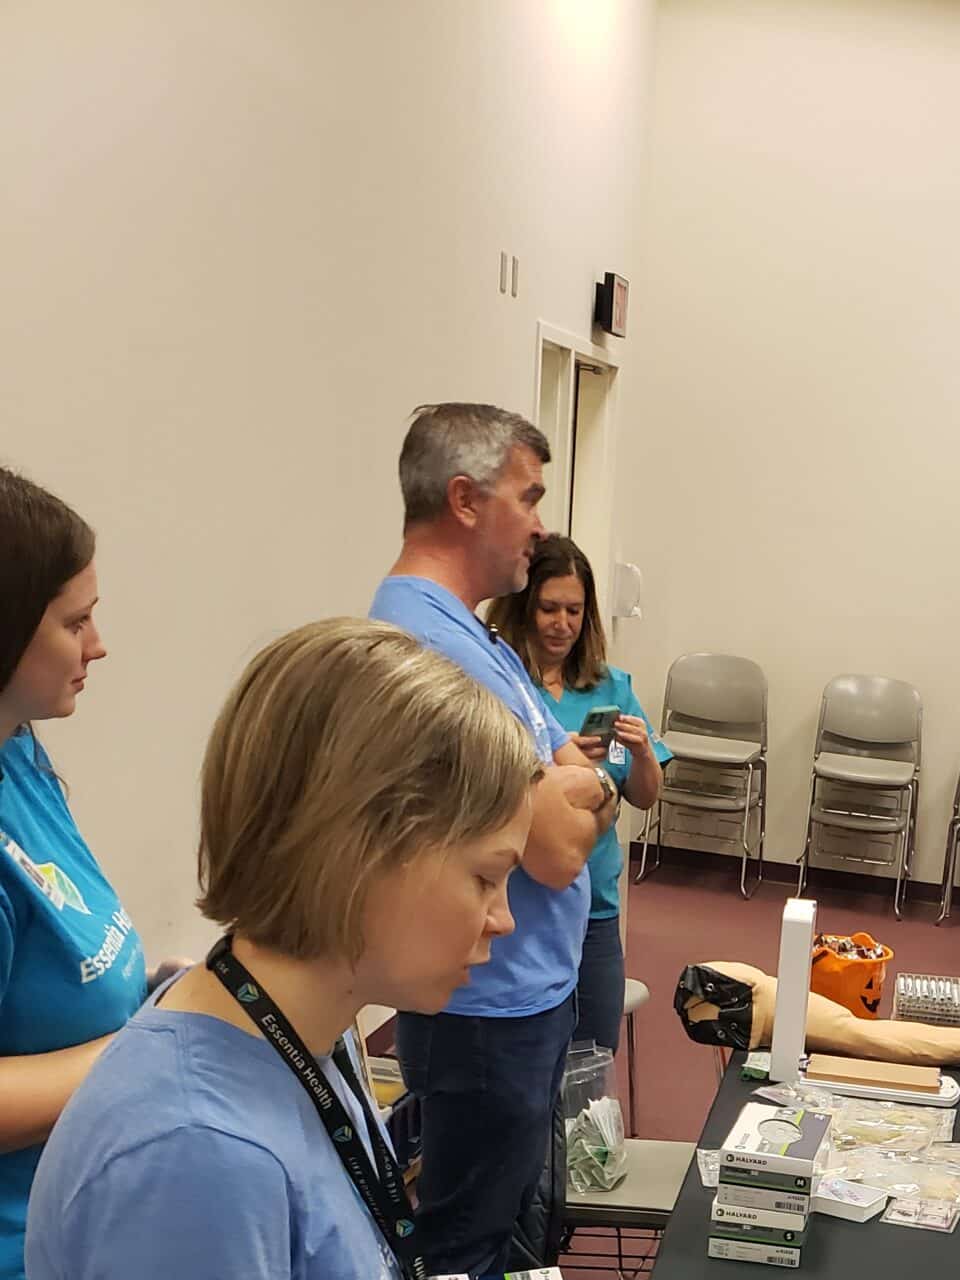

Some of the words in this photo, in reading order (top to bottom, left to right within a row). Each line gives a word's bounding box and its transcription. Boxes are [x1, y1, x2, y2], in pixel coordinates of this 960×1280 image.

[262, 1013, 305, 1070] Essentia
[303, 1066, 333, 1110] Health
[735, 1156, 768, 1166] HALYARD
[726, 1210, 758, 1220] HALYARD
